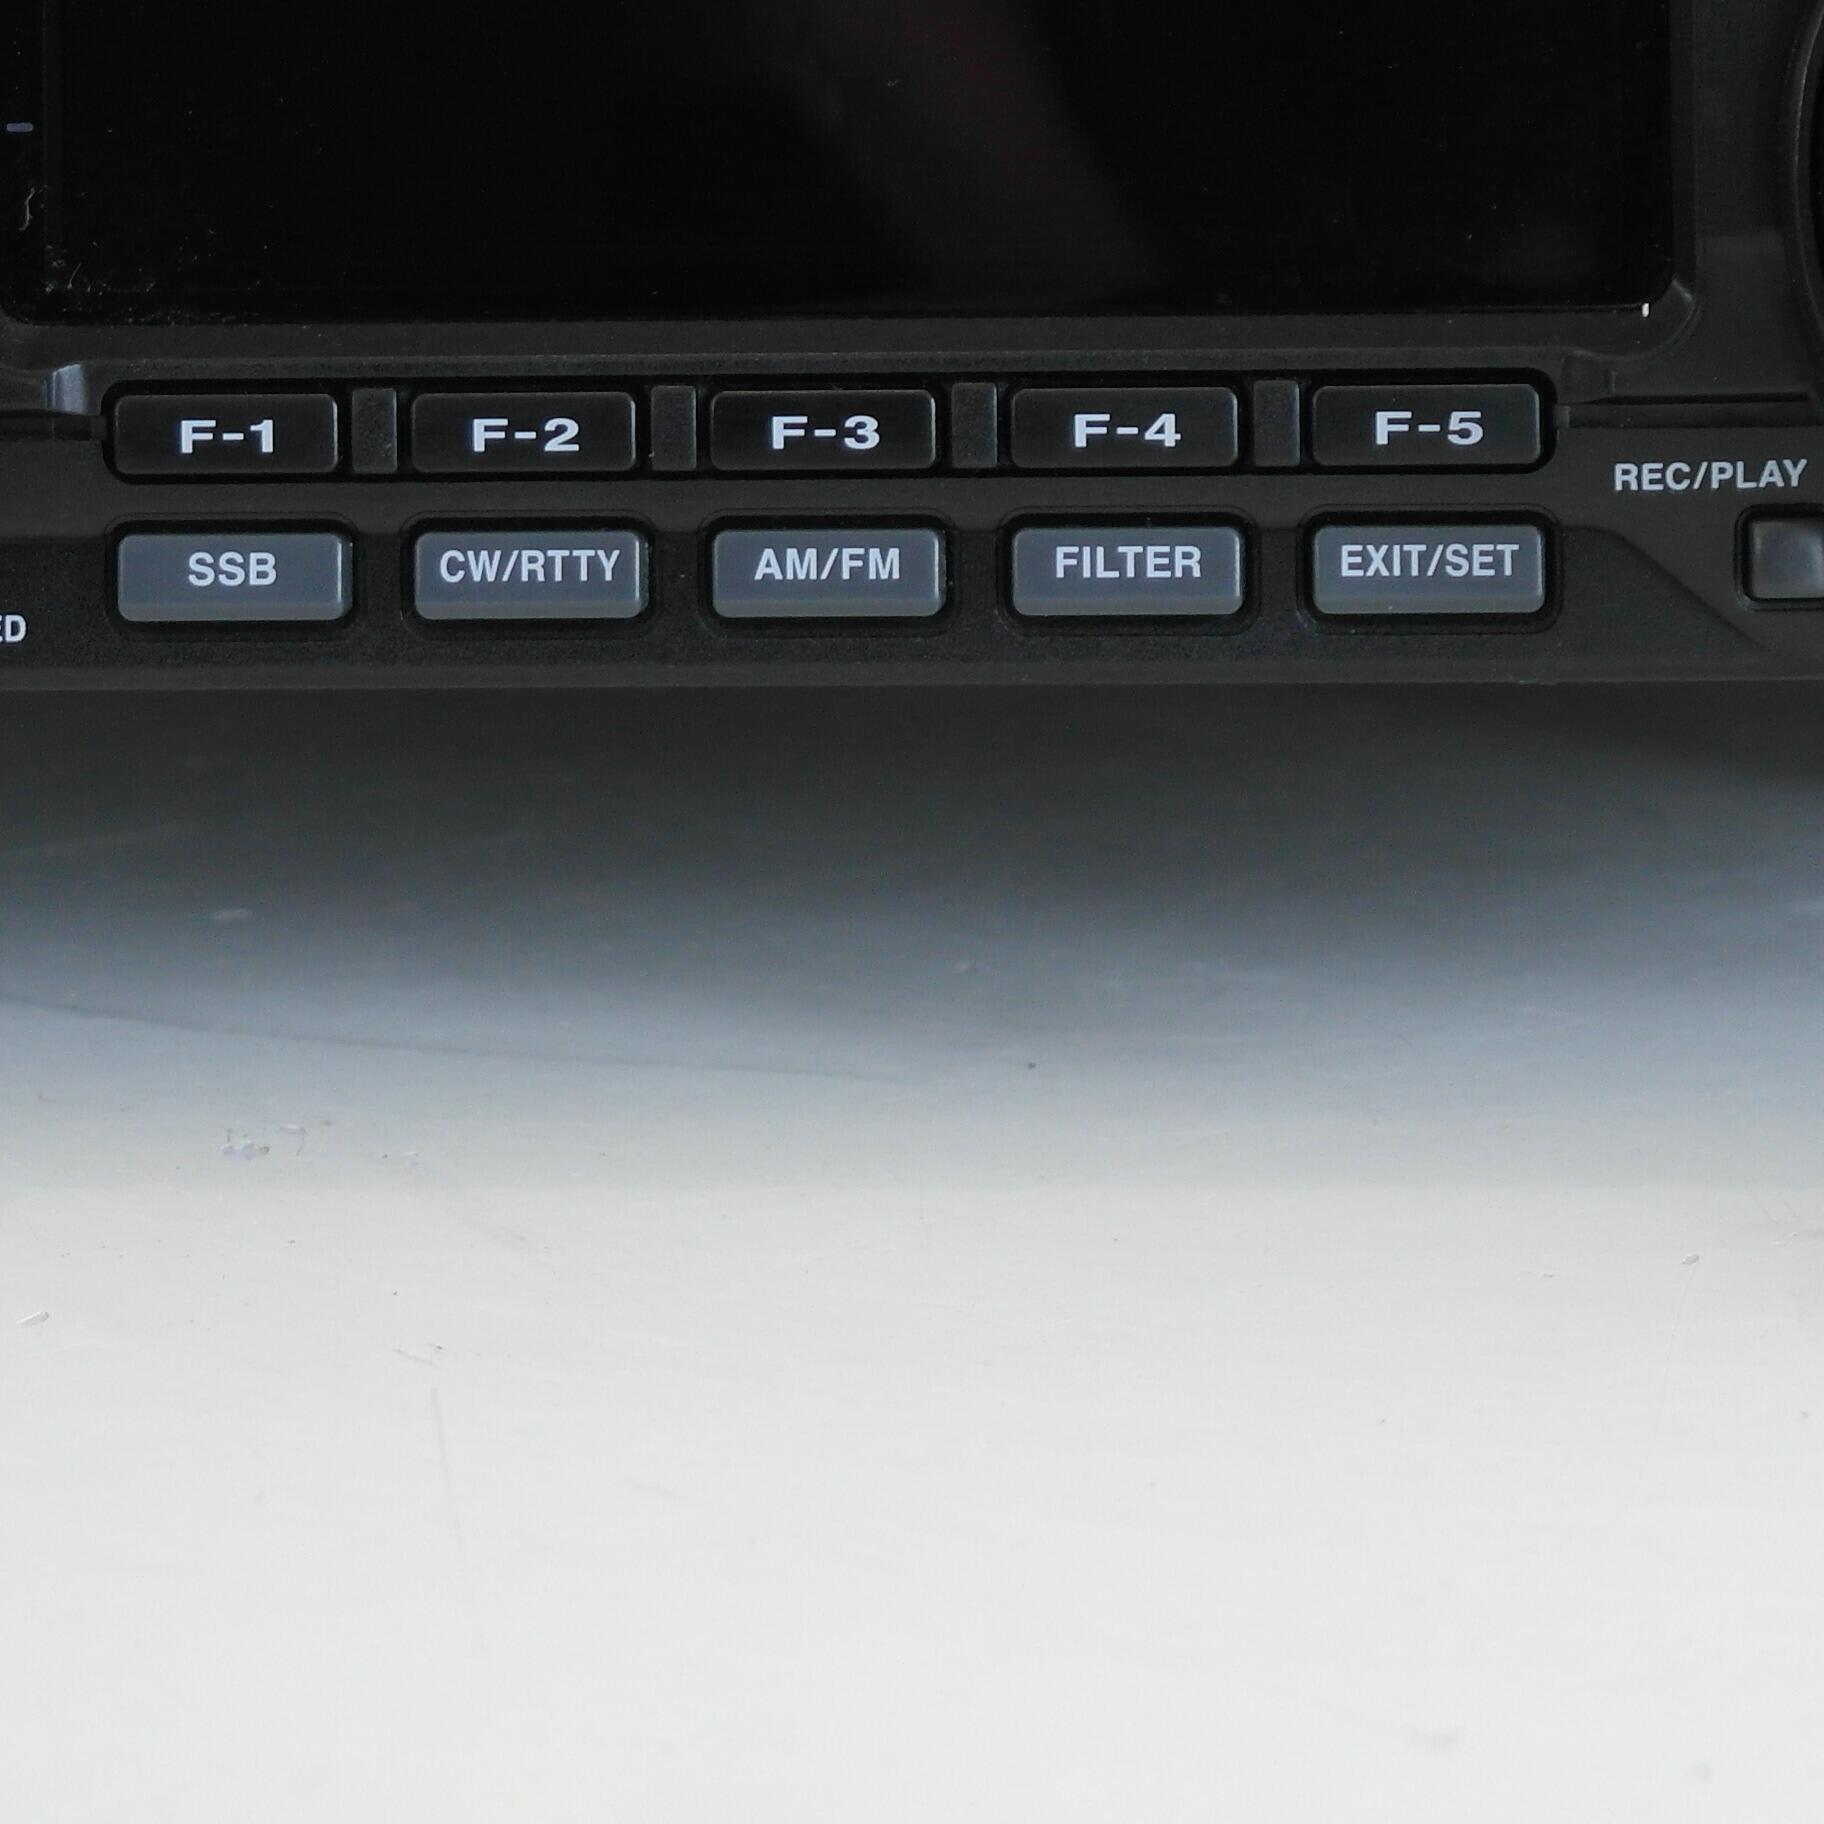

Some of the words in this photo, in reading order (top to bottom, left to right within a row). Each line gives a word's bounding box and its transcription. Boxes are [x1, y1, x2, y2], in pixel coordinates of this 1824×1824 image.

[180, 419, 274, 454] F-1
[472, 417, 580, 453] F-2
[771, 415, 880, 450] F-3
[1074, 413, 1182, 448] F-4
[1375, 411, 1484, 446] F-5
[1614, 458, 1808, 492] REC/PLAY
[188, 551, 277, 587] SSB
[439, 549, 620, 583] CW/RTTY
[754, 547, 900, 581] AM/FM
[1055, 545, 1201, 579] FILTER
[1340, 543, 1520, 577] EXIT/SET
